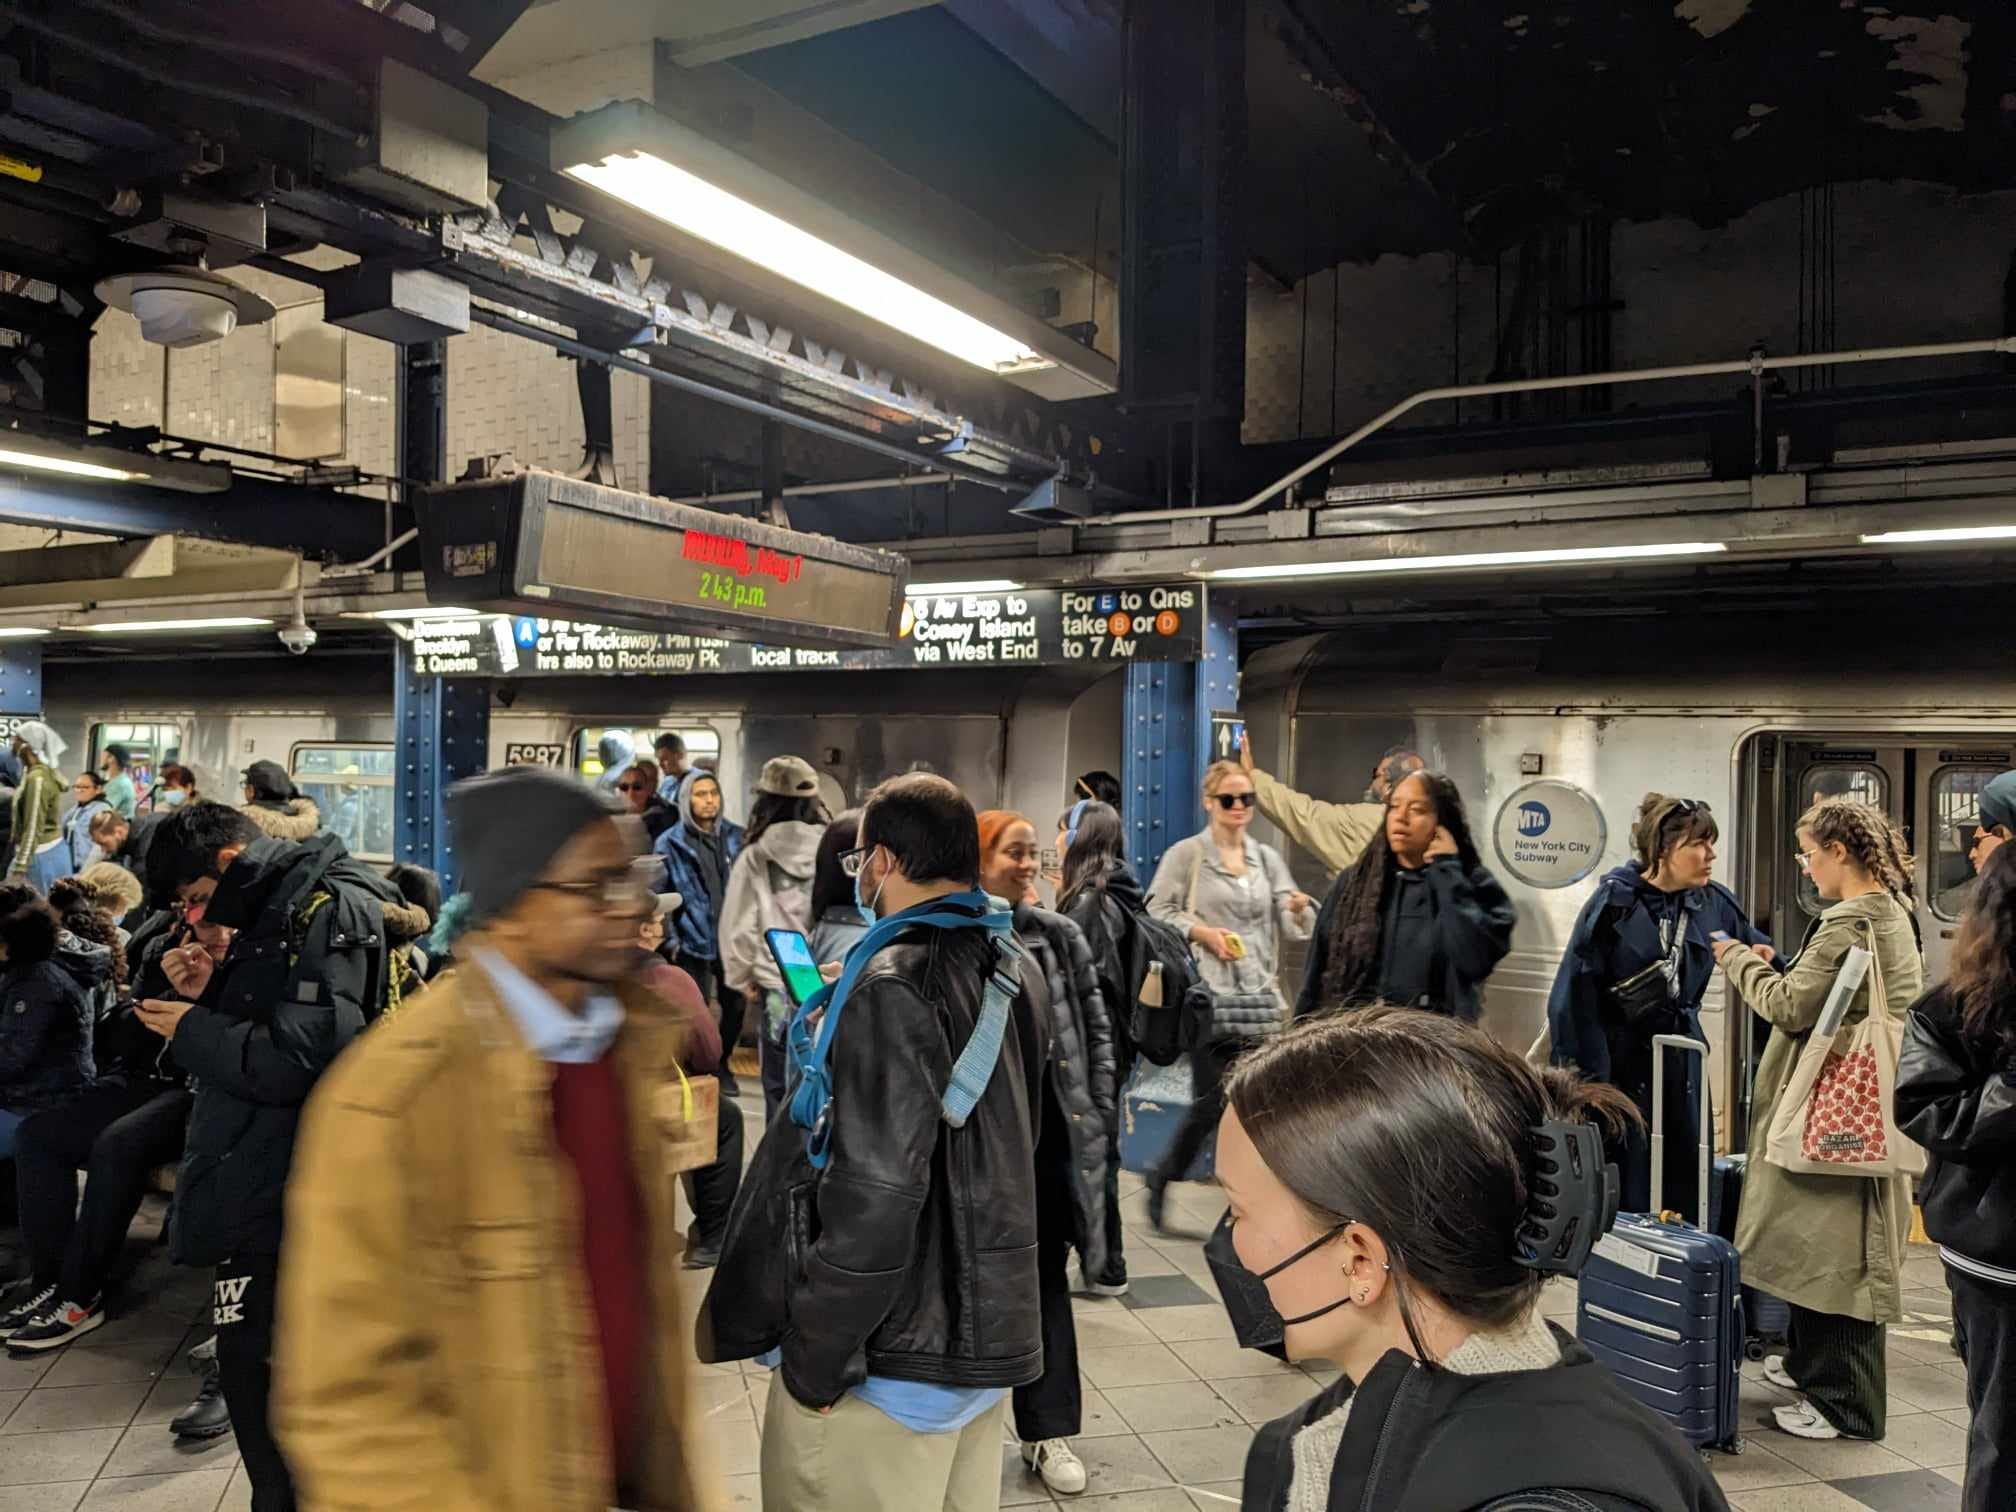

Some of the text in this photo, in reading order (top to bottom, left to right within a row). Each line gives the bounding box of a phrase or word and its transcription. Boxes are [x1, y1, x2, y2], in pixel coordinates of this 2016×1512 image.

[933, 598, 957, 619] Av
[962, 596, 1000, 620] Exp
[1006, 595, 1027, 615] to
[1062, 592, 1095, 613] For
[1120, 590, 1142, 610] to
[1149, 587, 1194, 609] Qns
[913, 616, 1036, 643] Coney Island
[1062, 614, 1107, 636] take
[1132, 615, 1155, 633] or
[414, 637, 470, 656] Brooklyn
[537, 637, 554, 651] or
[556, 632, 580, 651] Far
[582, 631, 662, 652] Rockaway.
[914, 638, 1039, 661] via West End
[1062, 636, 1136, 658] to 7 Av
[415, 655, 479, 673] & Queens
[537, 649, 720, 671] hrs also to Rockaway Pk
[751, 646, 839, 666] local track
[1518, 809, 1545, 829] MTA
[1514, 840, 1591, 854] New York City
[1514, 851, 1559, 865] Subway
